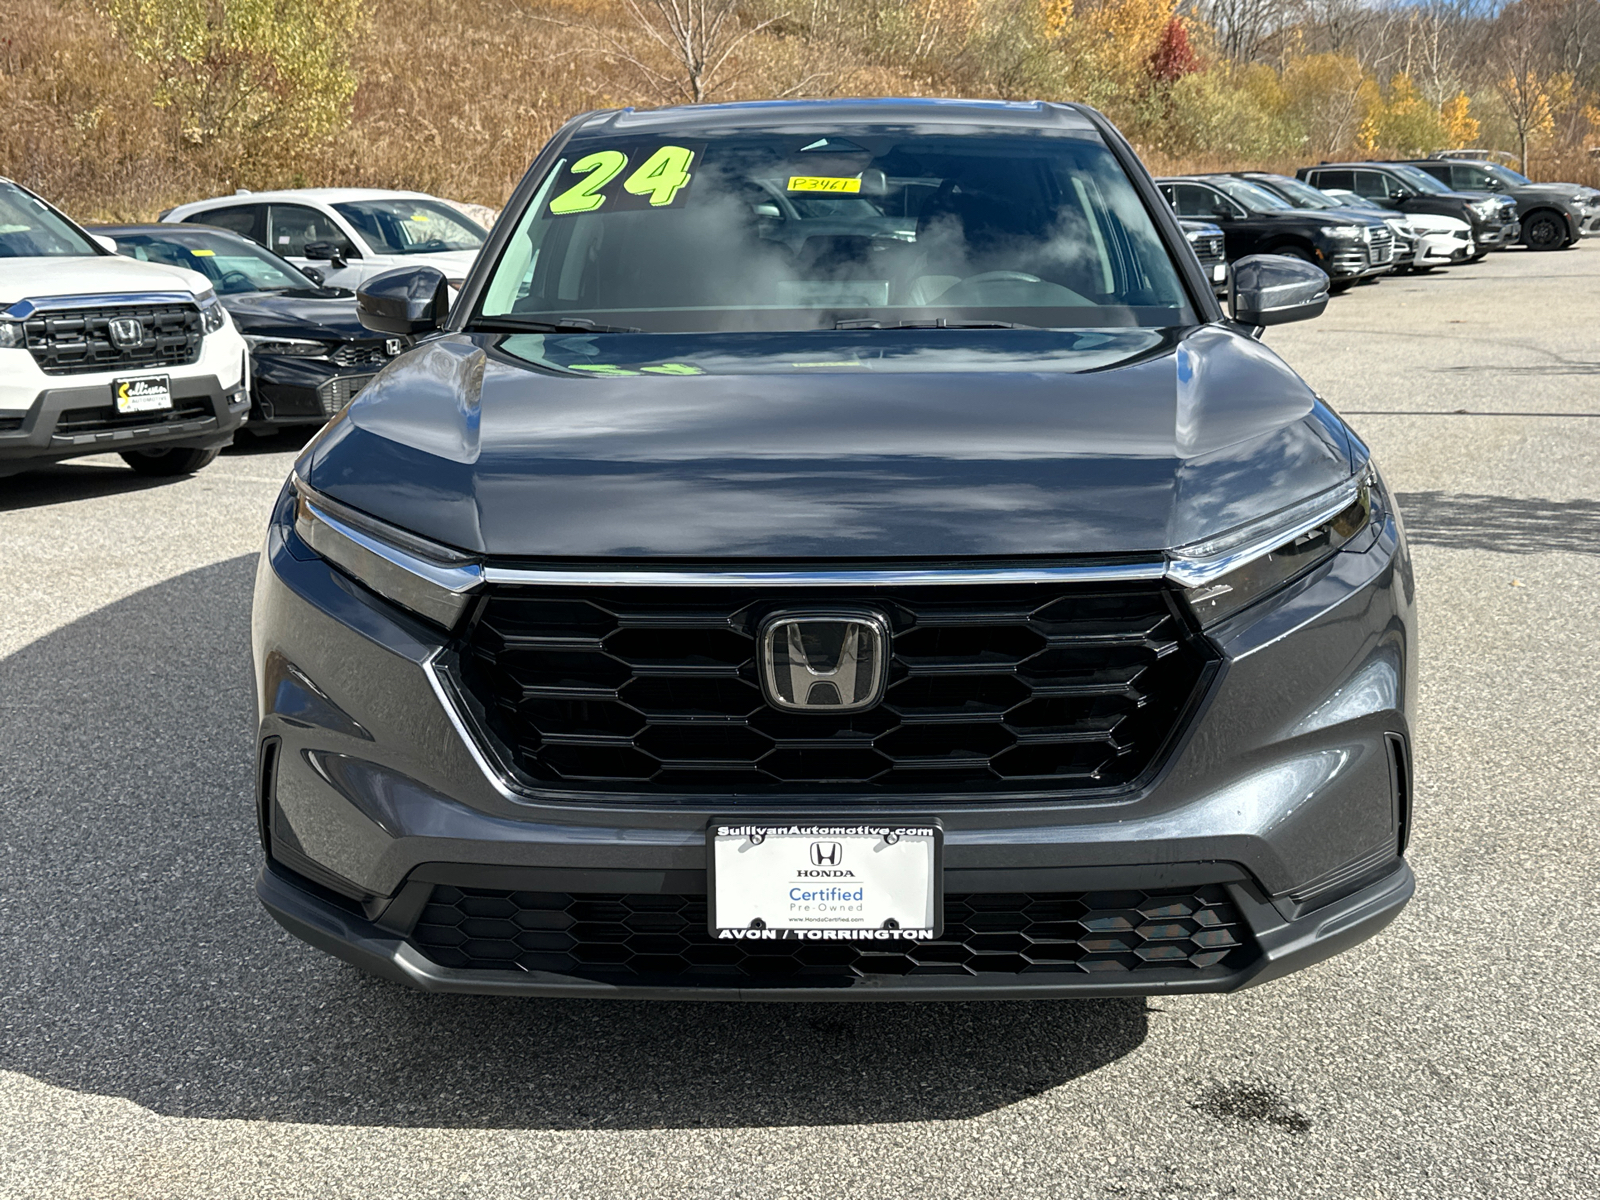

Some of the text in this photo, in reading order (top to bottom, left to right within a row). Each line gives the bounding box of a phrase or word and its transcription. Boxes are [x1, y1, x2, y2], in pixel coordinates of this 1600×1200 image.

[549, 145, 695, 215] 24
[793, 178, 848, 190] P3461
[796, 869, 856, 878] HONDA
[789, 887, 863, 901] Certified
[790, 903, 863, 911] Pre-Owned
[718, 929, 776, 940] AVON
[794, 929, 933, 940] TORRINGTON
